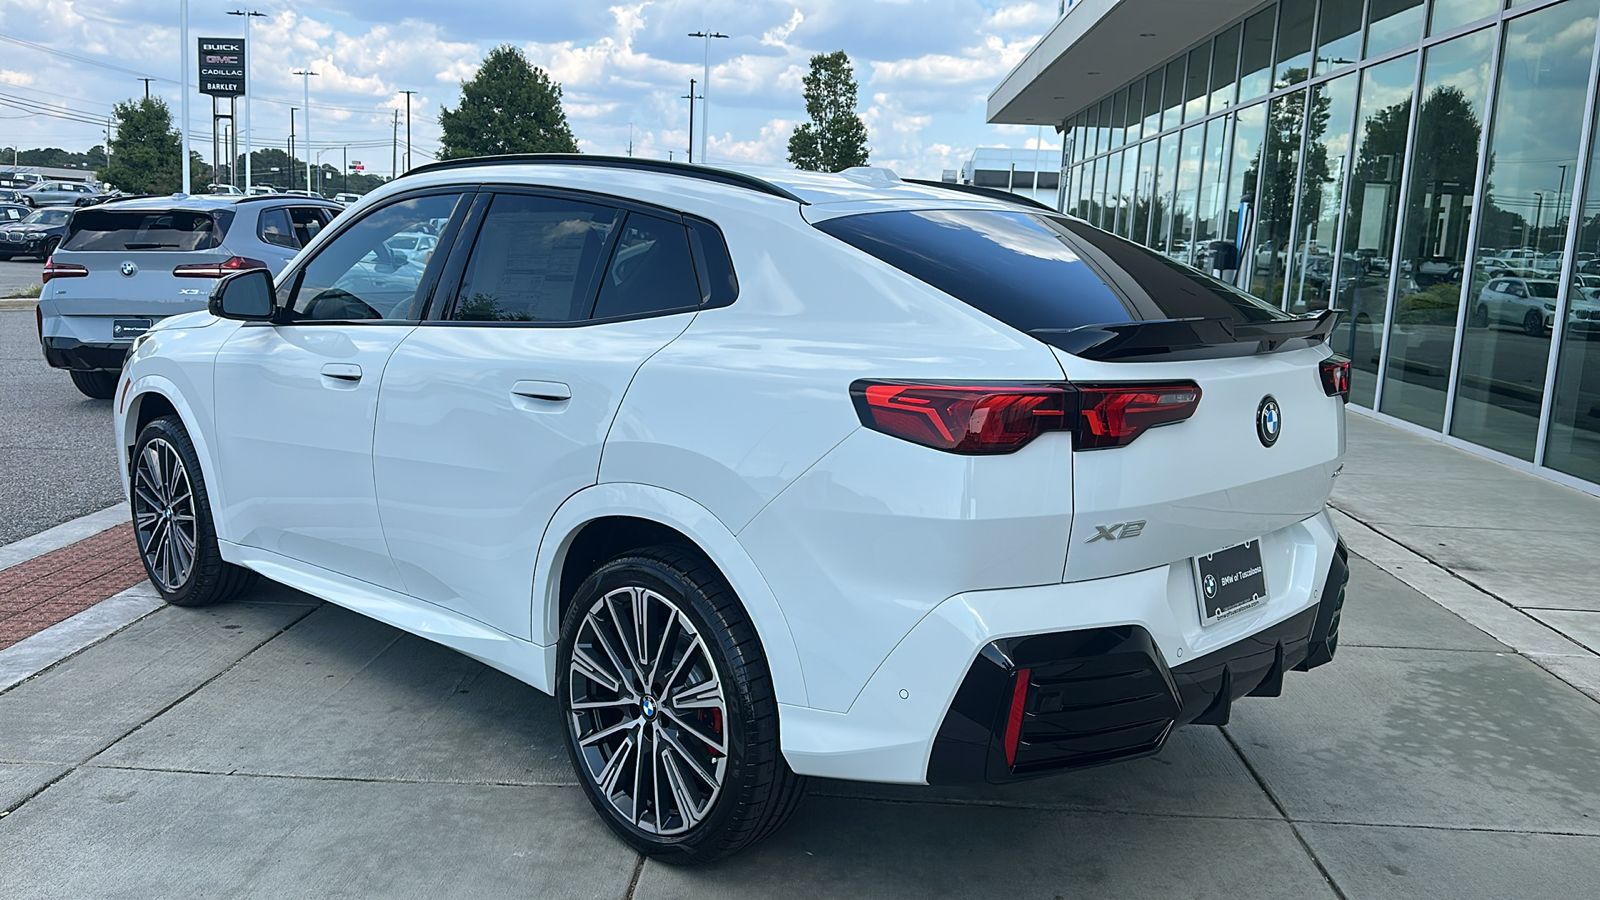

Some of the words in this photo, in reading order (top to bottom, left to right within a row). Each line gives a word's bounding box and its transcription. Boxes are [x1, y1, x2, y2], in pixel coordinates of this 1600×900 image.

[206, 55, 238, 64] GMC
[1084, 519, 1147, 543] X2
[1221, 574, 1234, 587] BMW
[1238, 566, 1262, 580] Tuscaloosa
